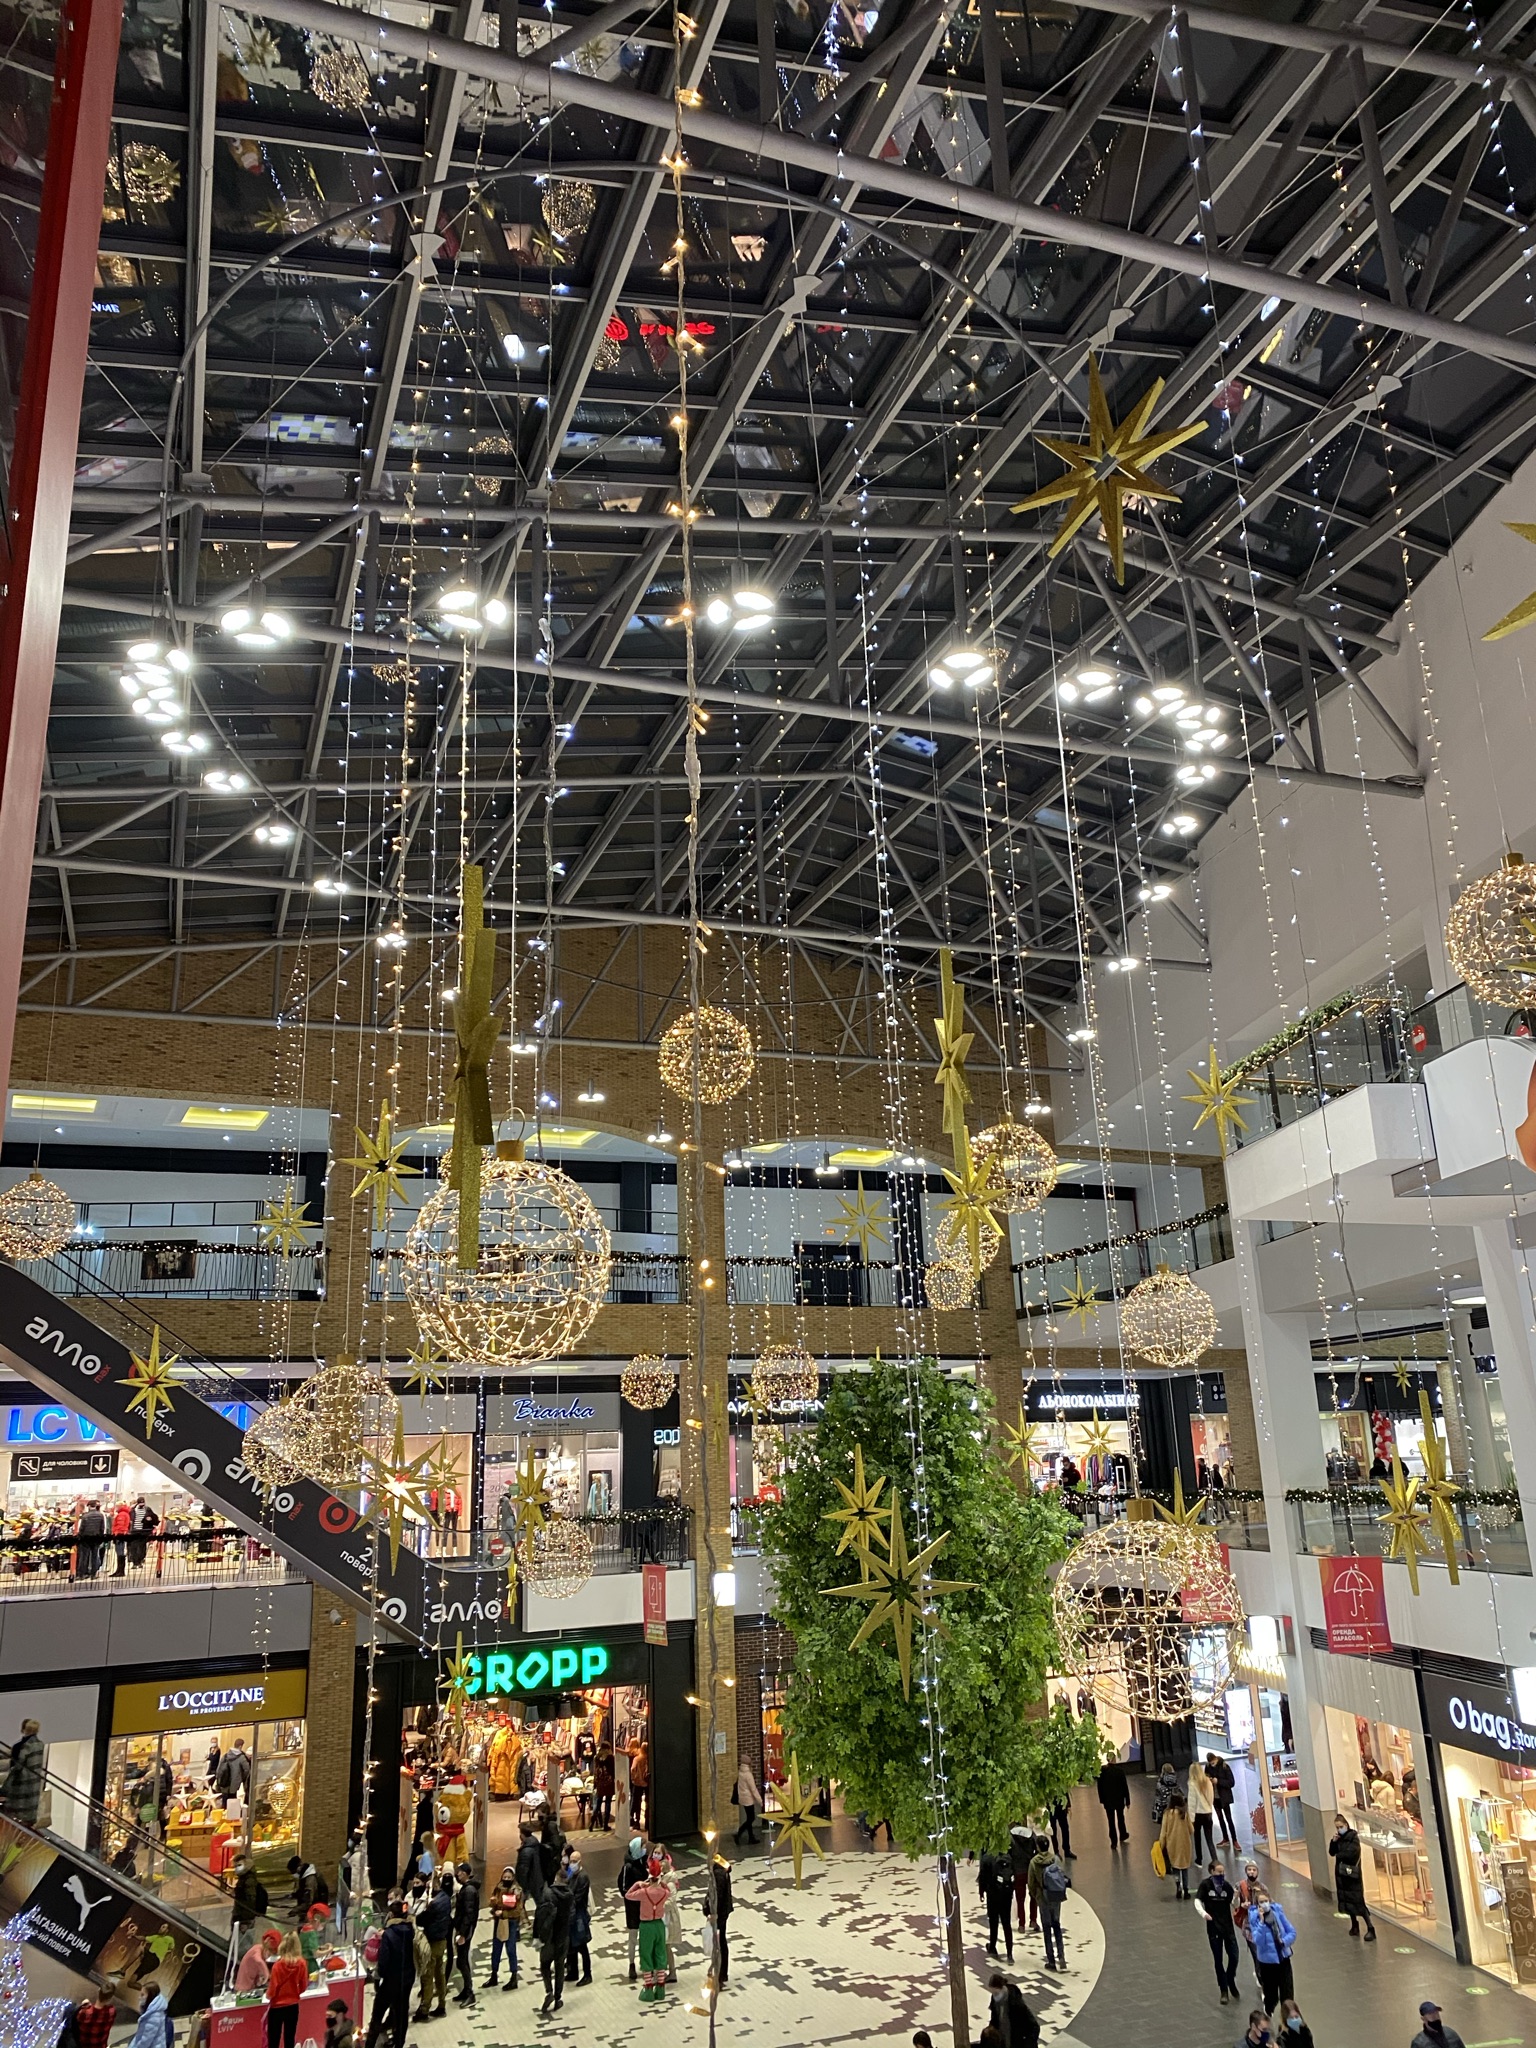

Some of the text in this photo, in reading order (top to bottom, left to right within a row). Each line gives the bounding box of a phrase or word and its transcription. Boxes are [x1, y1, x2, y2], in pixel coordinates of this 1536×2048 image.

[134, 1405, 175, 1437] поерх
[513, 1398, 595, 1421] Bianka
[8, 1407, 68, 1441] LC
[359, 1547, 373, 1562] 2
[461, 1646, 608, 1695] CROPP
[46, 1939, 72, 1957] ПОВЕРХ
[65, 1932, 91, 1955] PUMA
[217, 2024, 235, 2033] LVIV
